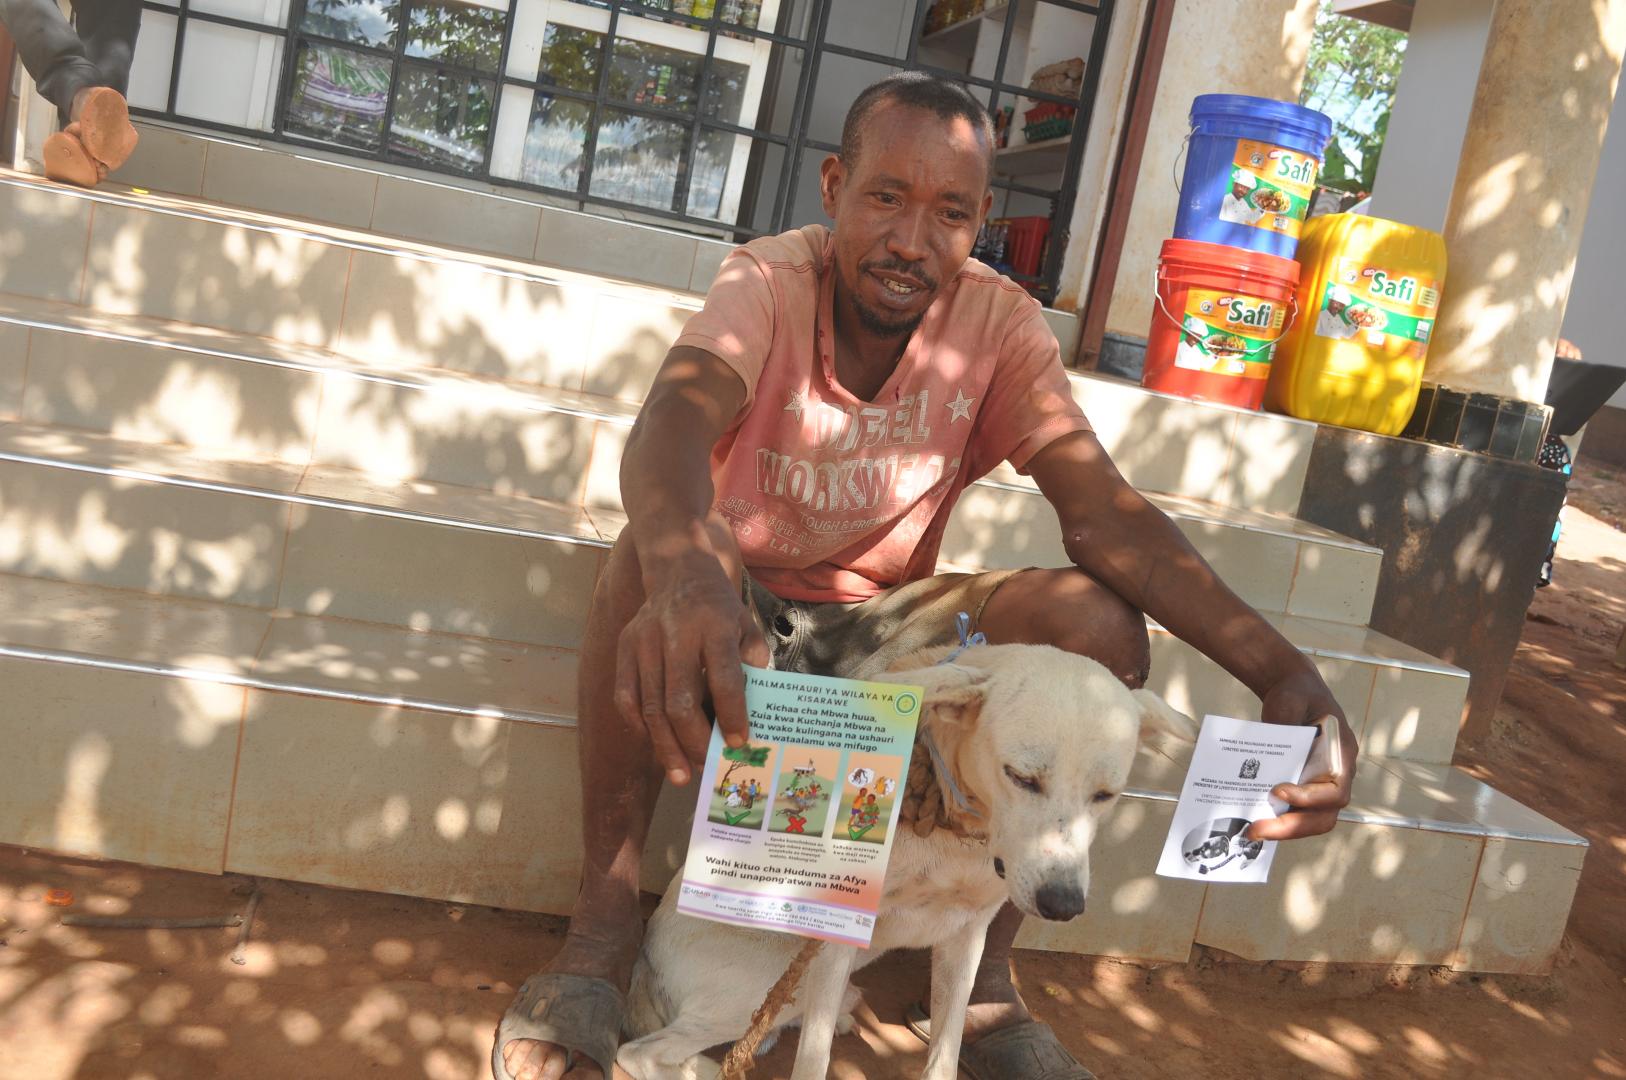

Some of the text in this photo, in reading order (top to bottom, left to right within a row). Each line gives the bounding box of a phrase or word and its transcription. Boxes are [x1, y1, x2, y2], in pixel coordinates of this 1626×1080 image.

[1278, 154, 1313, 184] Safi
[1372, 272, 1415, 301] Safi
[1228, 300, 1272, 327] Safi
[756, 448, 960, 513] WORKWEA
[799, 511, 841, 532] TOUGH
[751, 678, 894, 702] HALMASHAURI YA WILAYA YA
[797, 695, 849, 707] KISARAWE
[750, 710, 772, 720] Zuia
[774, 713, 795, 723] kwa
[797, 716, 841, 730] Kuchanja
[843, 722, 872, 732] Mbwa
[766, 703, 799, 714] Kichaa
[801, 707, 818, 716] cha
[820, 709, 849, 719] Mbwa
[749, 720, 765, 729] aka
[767, 723, 793, 733] wako
[795, 726, 842, 739] kulingana
[859, 734, 894, 744] ushauri
[755, 732, 769, 740] wa
[772, 734, 825, 746] wataalamu
[843, 741, 878, 753] mifugo
[705, 856, 867, 886] Wahi kituo cha Huduma za Afya
[711, 867, 737, 879] pindi
[814, 880, 827, 889] na
[829, 882, 860, 895] Mbwa
